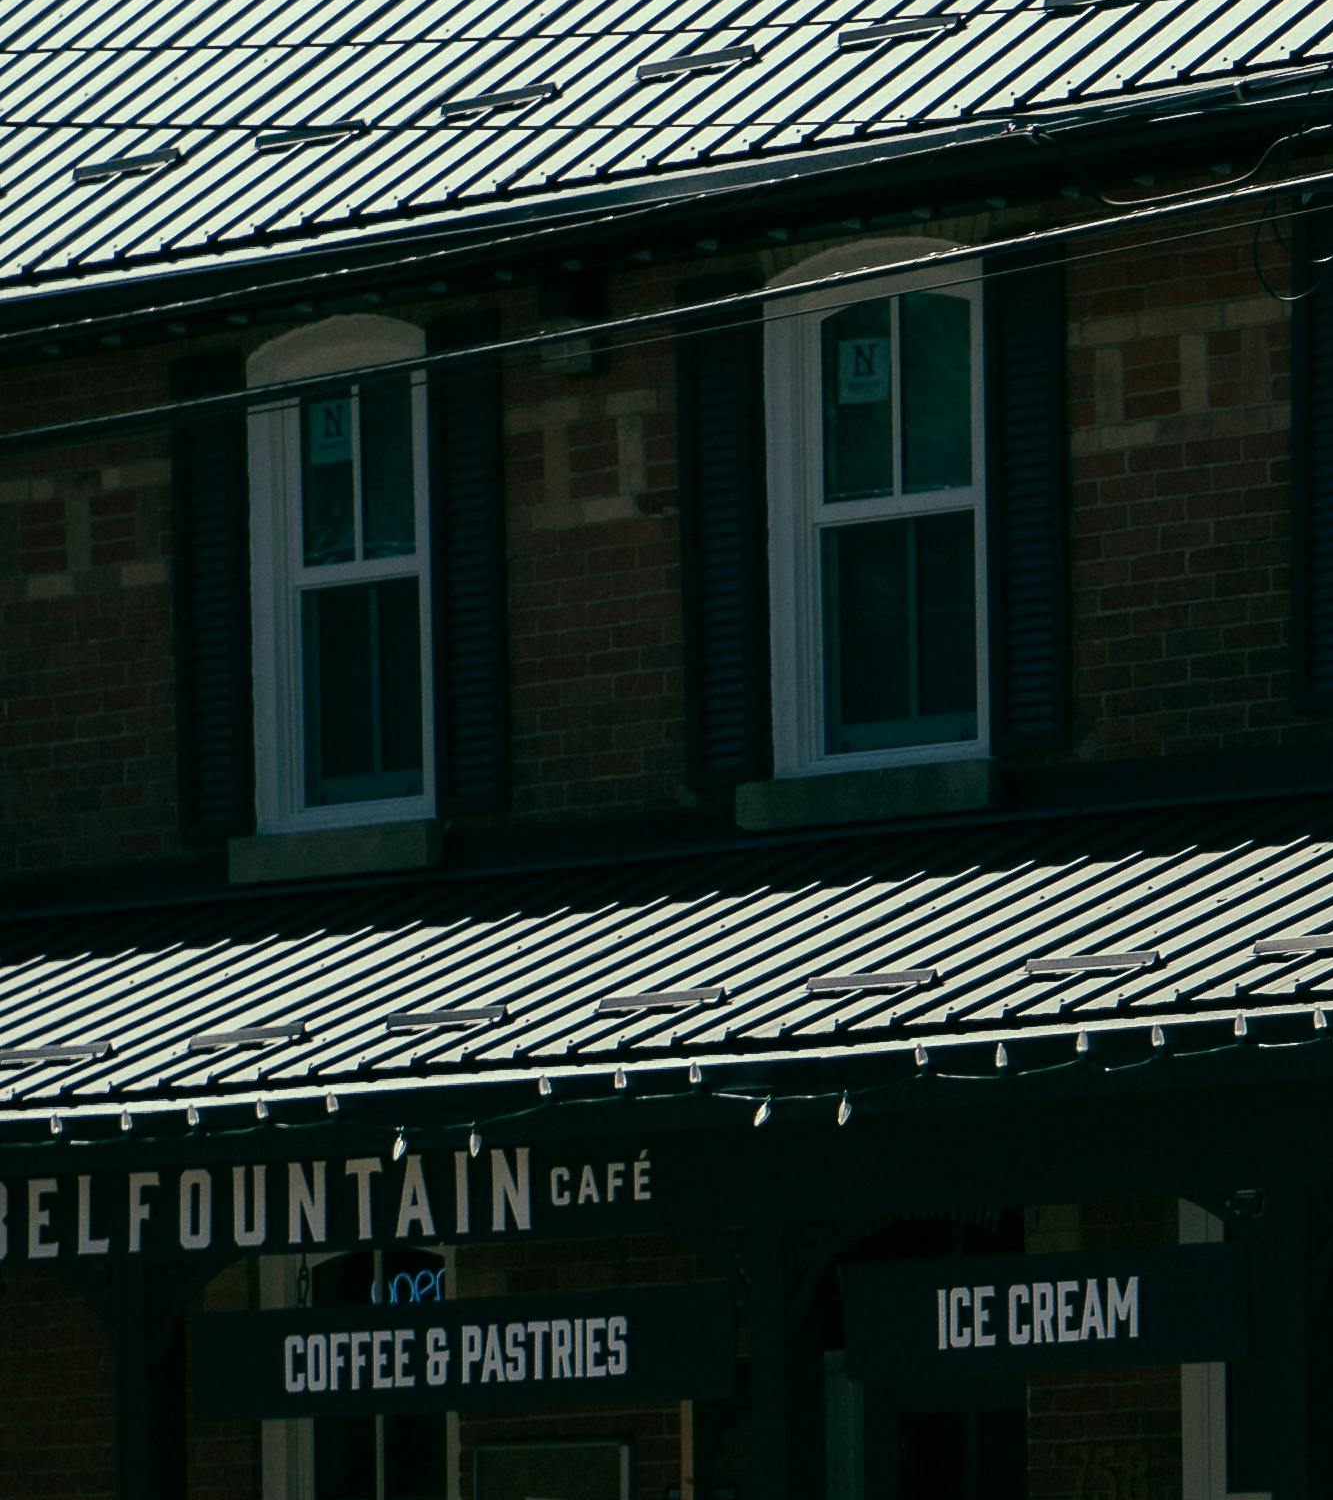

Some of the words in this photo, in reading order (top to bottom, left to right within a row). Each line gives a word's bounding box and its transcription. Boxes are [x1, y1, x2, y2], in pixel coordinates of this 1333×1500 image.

[853, 343, 877, 377] N
[323, 404, 345, 438] N
[0, 1147, 533, 1263] ELFOUNTAIN
[549, 1148, 655, 1207] CAFÉ
[937, 1286, 997, 1350] ICE
[1008, 1276, 1140, 1346] CREAM
[282, 1328, 417, 1394] COFFEE
[425, 1326, 451, 1388] &
[460, 1315, 629, 1385] PASTRIES
